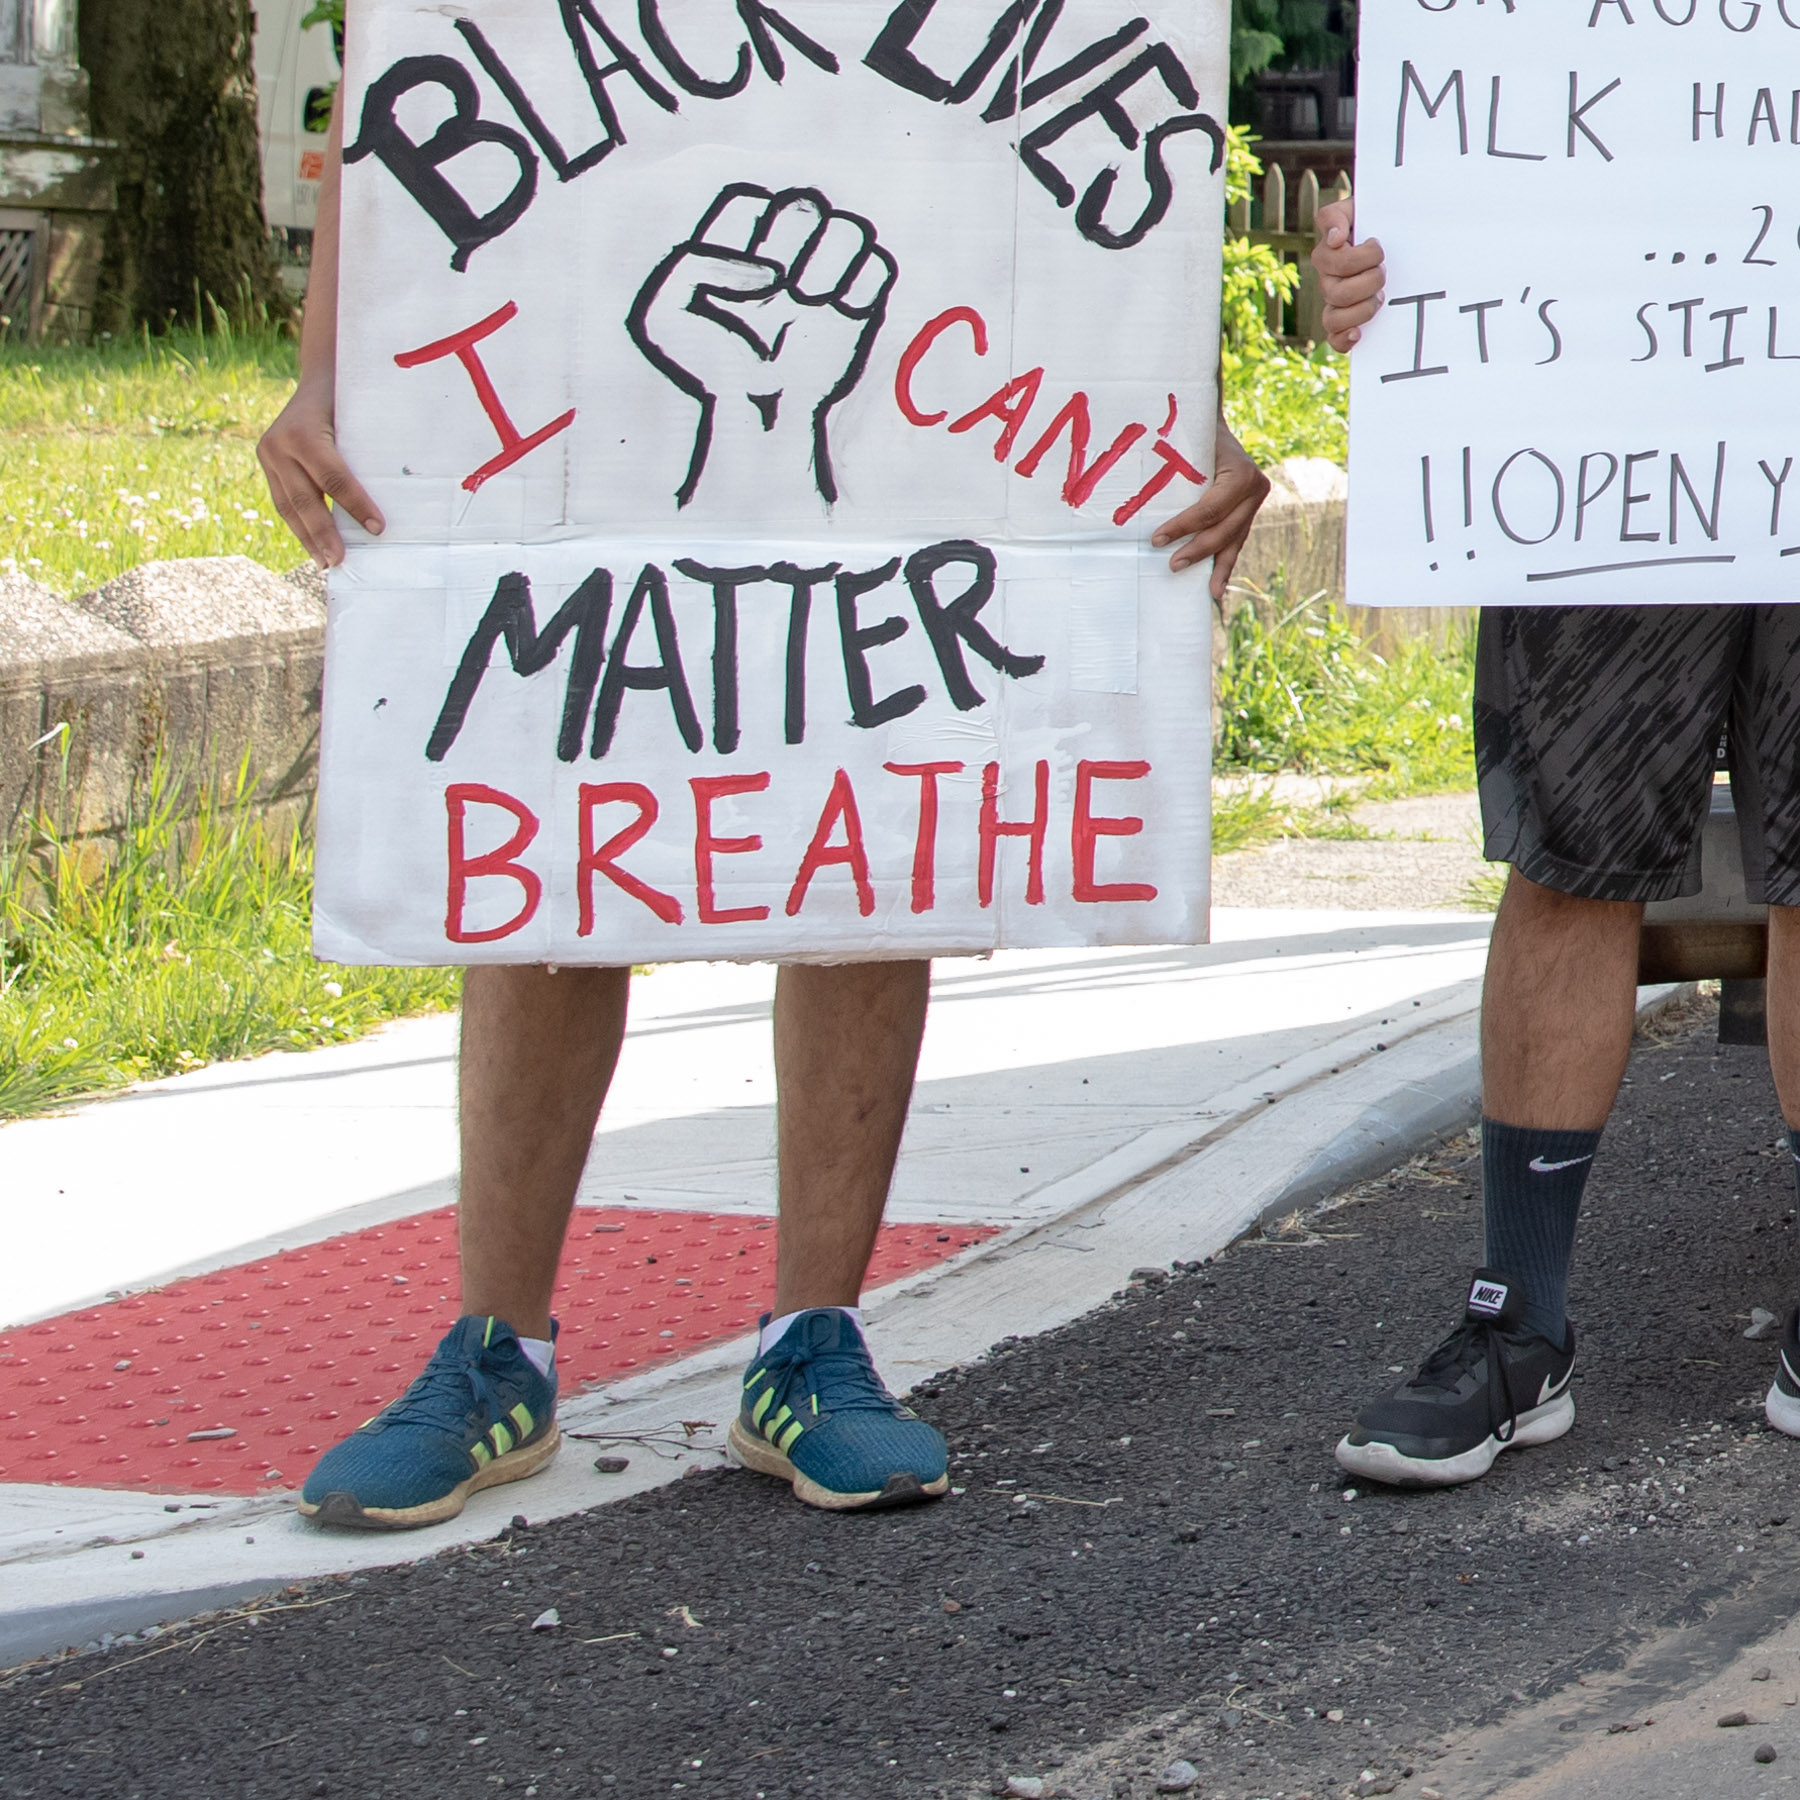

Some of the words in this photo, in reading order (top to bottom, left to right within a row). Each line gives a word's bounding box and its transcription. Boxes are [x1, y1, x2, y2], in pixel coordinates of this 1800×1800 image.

[1395, 60, 1621, 167] MLK
[1381, 287, 1561, 383] IT'S
[394, 301, 575, 491] I
[895, 306, 1207, 526] CAN'T
[427, 539, 1045, 761] MATTER
[444, 759, 1156, 943] BREATHE
[1473, 1286, 1503, 1304] NIKE
